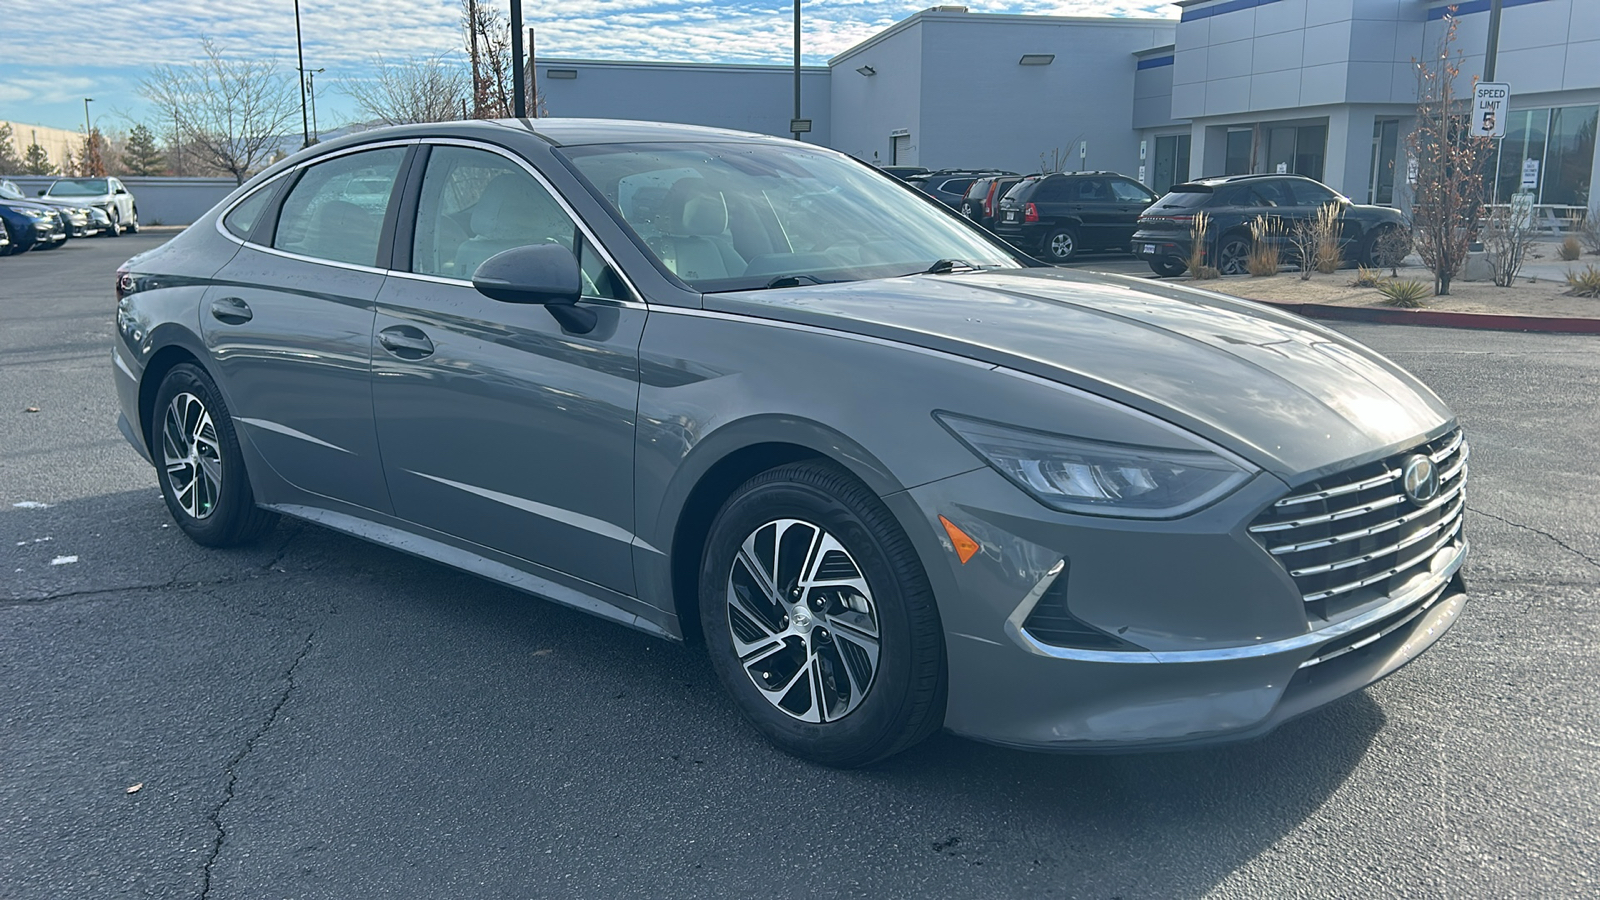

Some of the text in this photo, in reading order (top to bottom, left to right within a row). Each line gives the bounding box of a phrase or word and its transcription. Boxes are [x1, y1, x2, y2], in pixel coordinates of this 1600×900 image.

[1478, 89, 1505, 98] SPEED
[1480, 101, 1501, 109] LIMIT
[1482, 112, 1495, 131] 5
